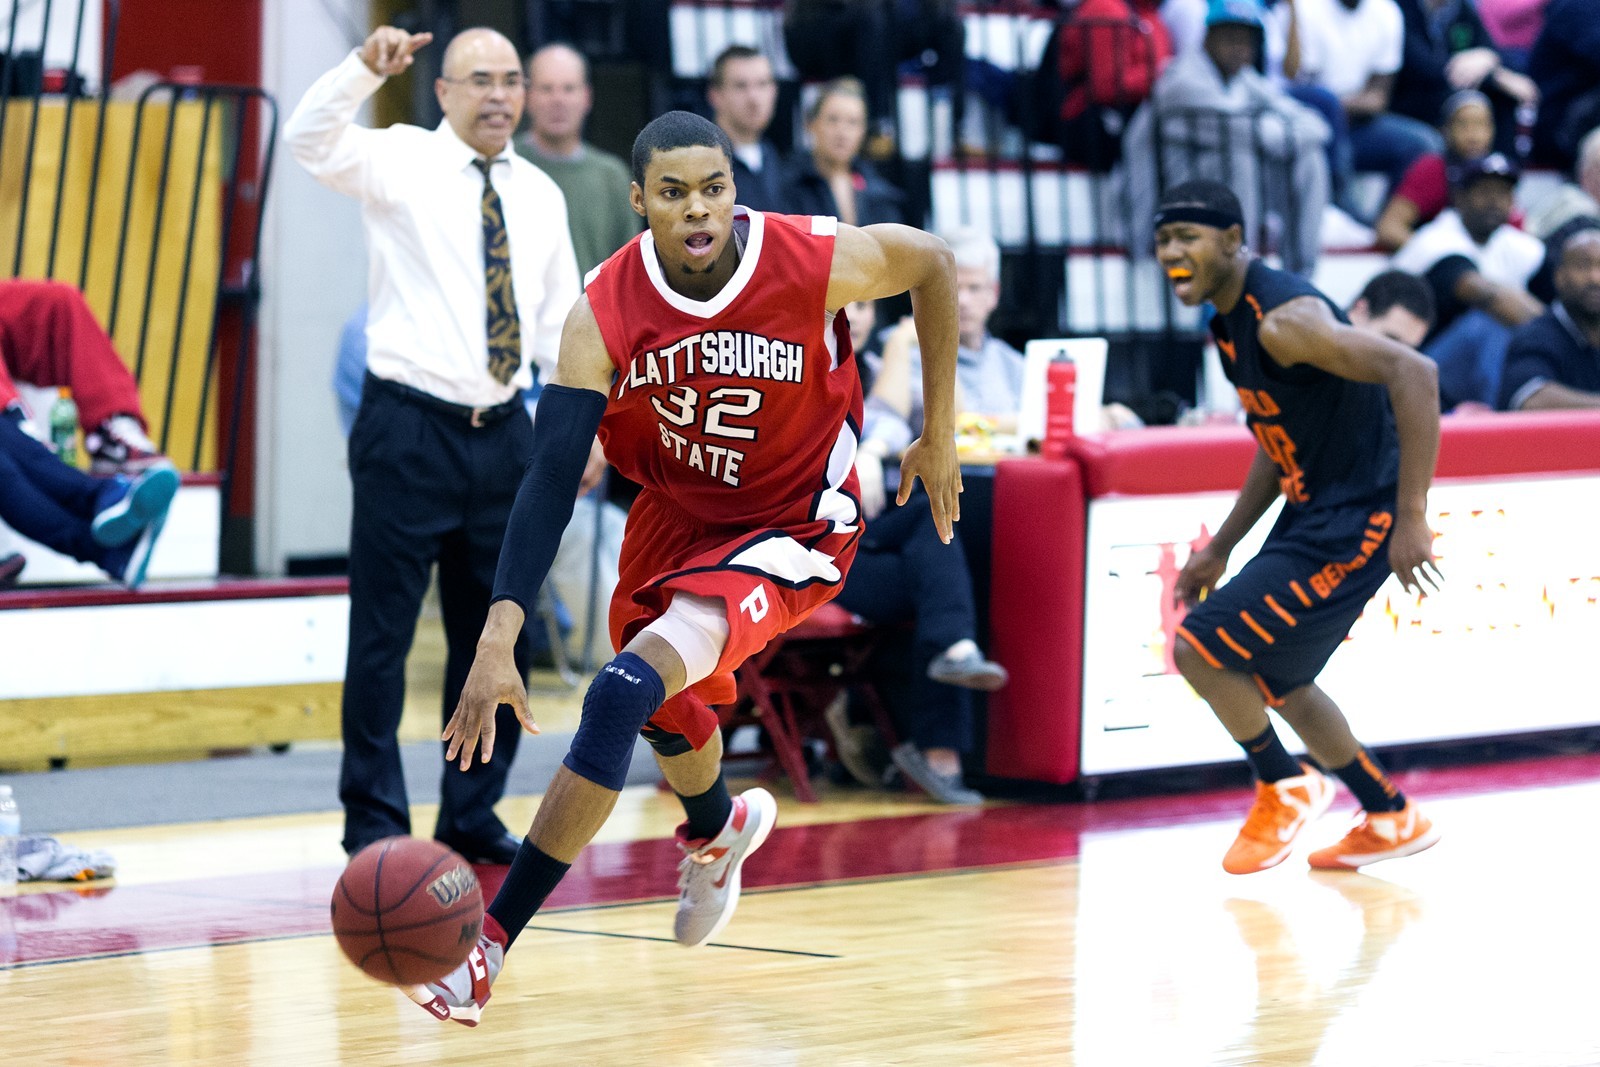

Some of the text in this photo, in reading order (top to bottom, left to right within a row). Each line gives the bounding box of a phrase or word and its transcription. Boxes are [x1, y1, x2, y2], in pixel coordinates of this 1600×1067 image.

[651, 385, 762, 440] 32
[658, 422, 744, 487] STATE
[740, 584, 769, 624] P
